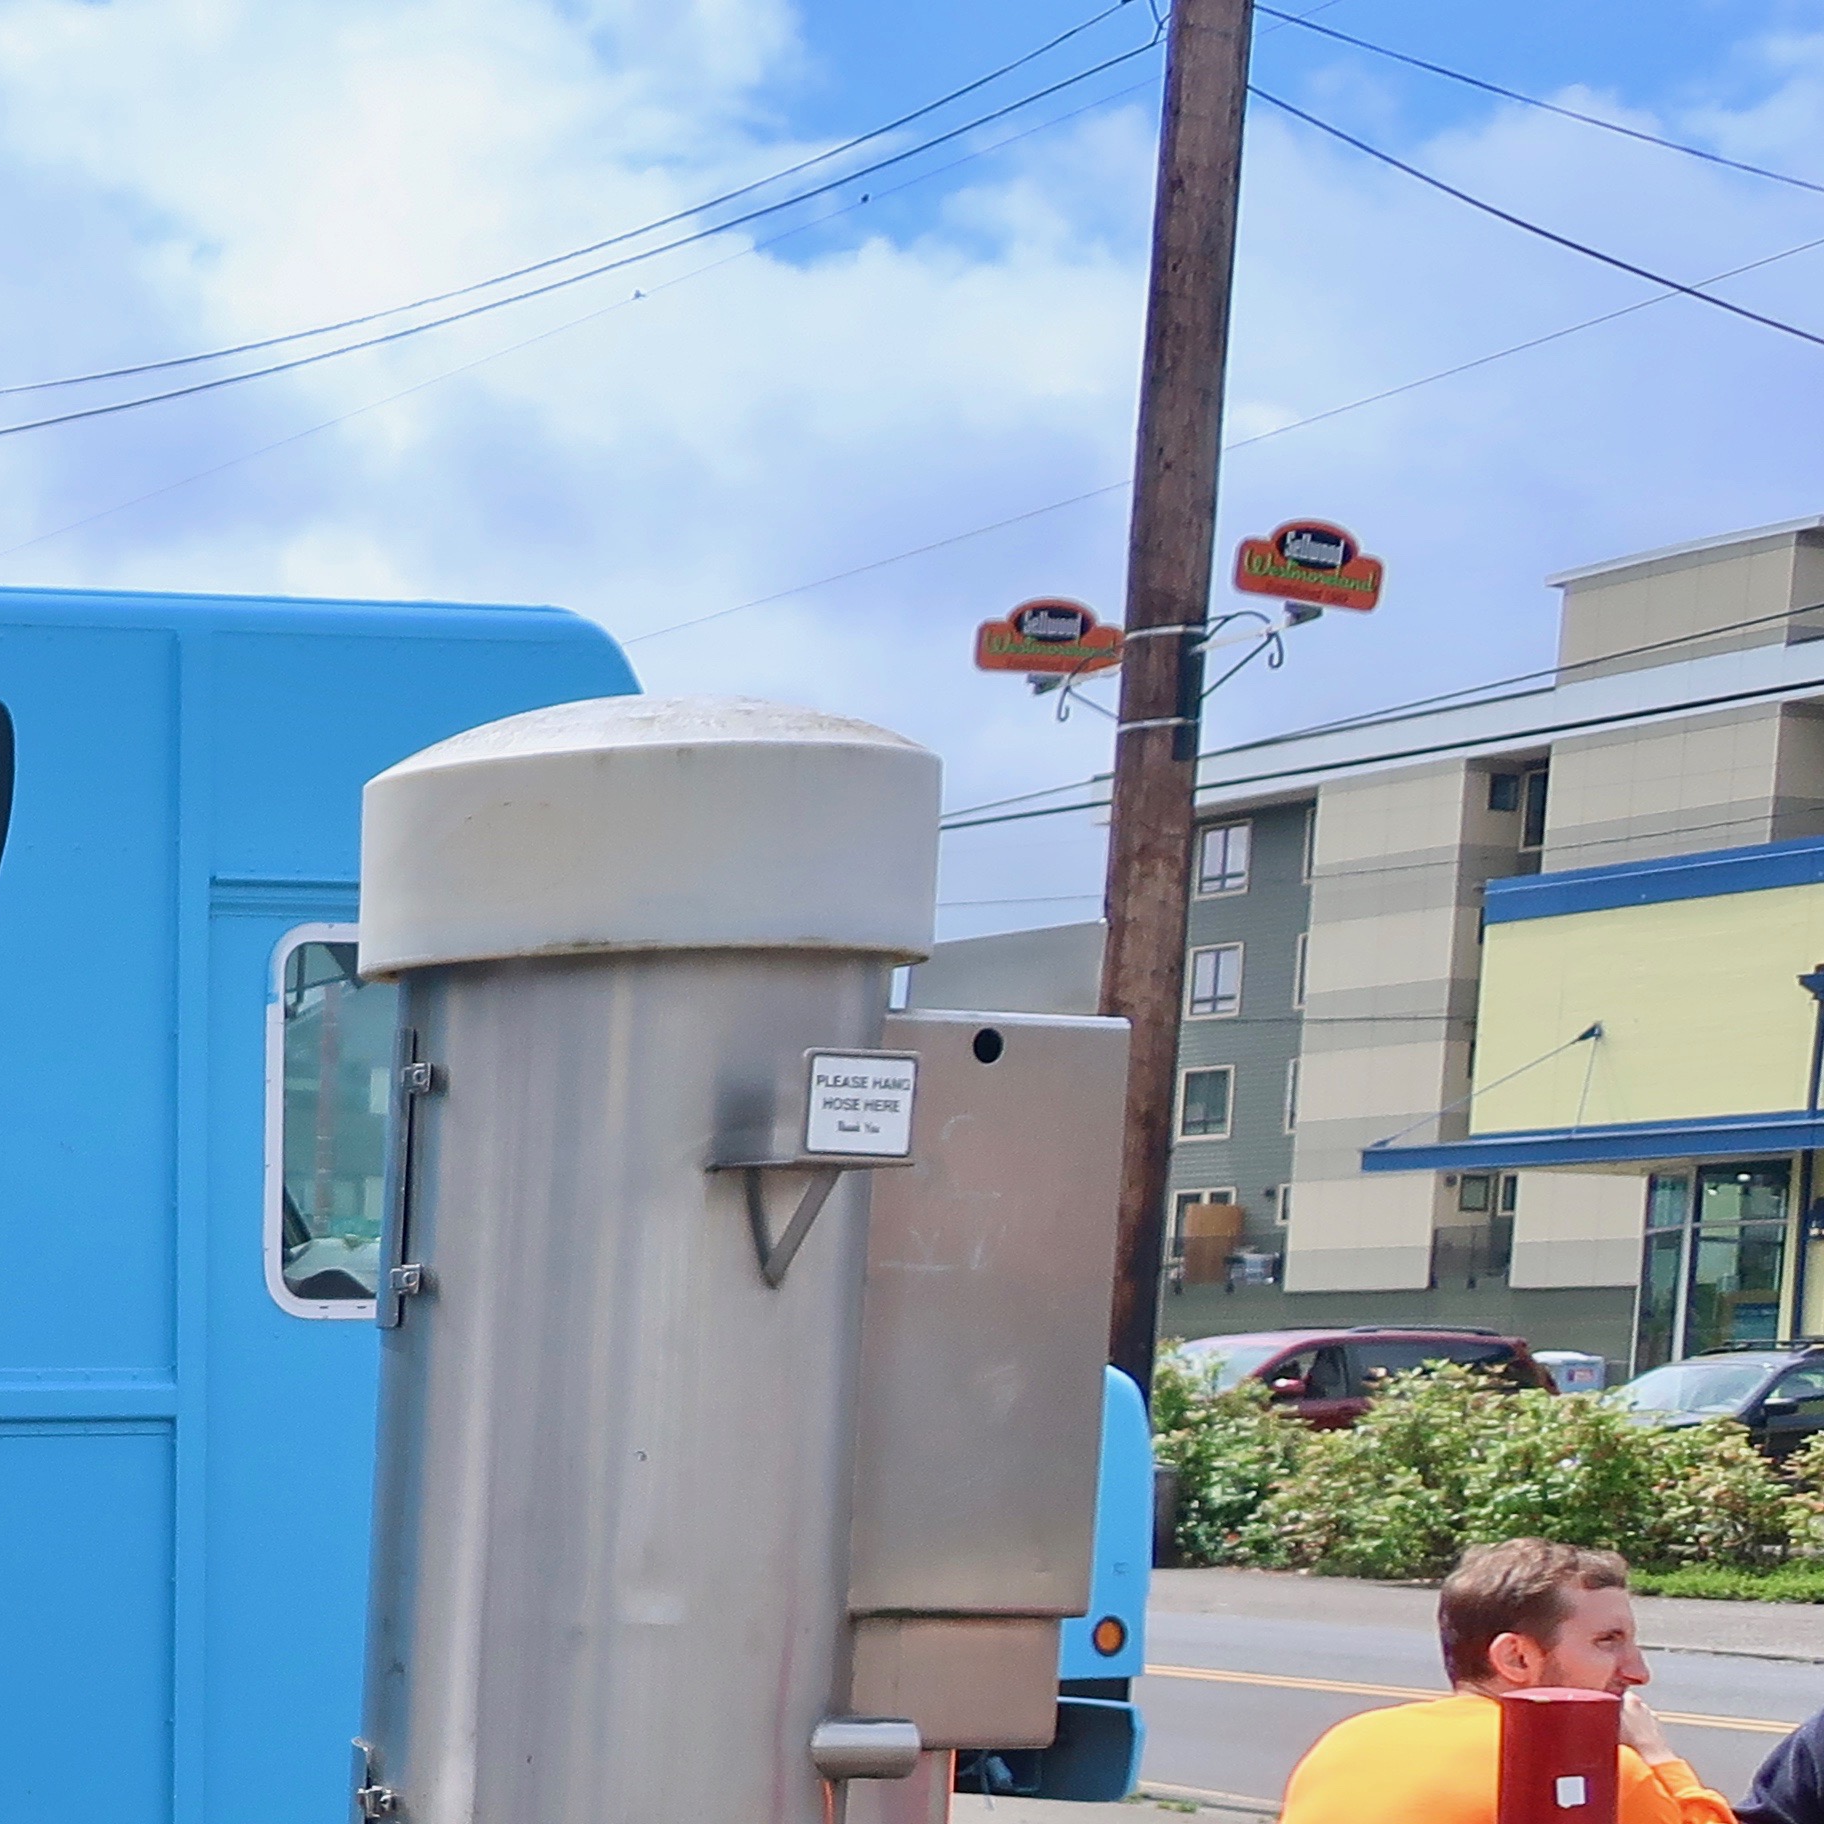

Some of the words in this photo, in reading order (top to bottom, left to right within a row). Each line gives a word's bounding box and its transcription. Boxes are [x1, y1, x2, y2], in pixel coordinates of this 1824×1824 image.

[816, 1074, 869, 1089] PLEASE
[872, 1077, 911, 1090] HANG
[822, 1097, 860, 1111] HOSE
[863, 1099, 900, 1113] HERE
